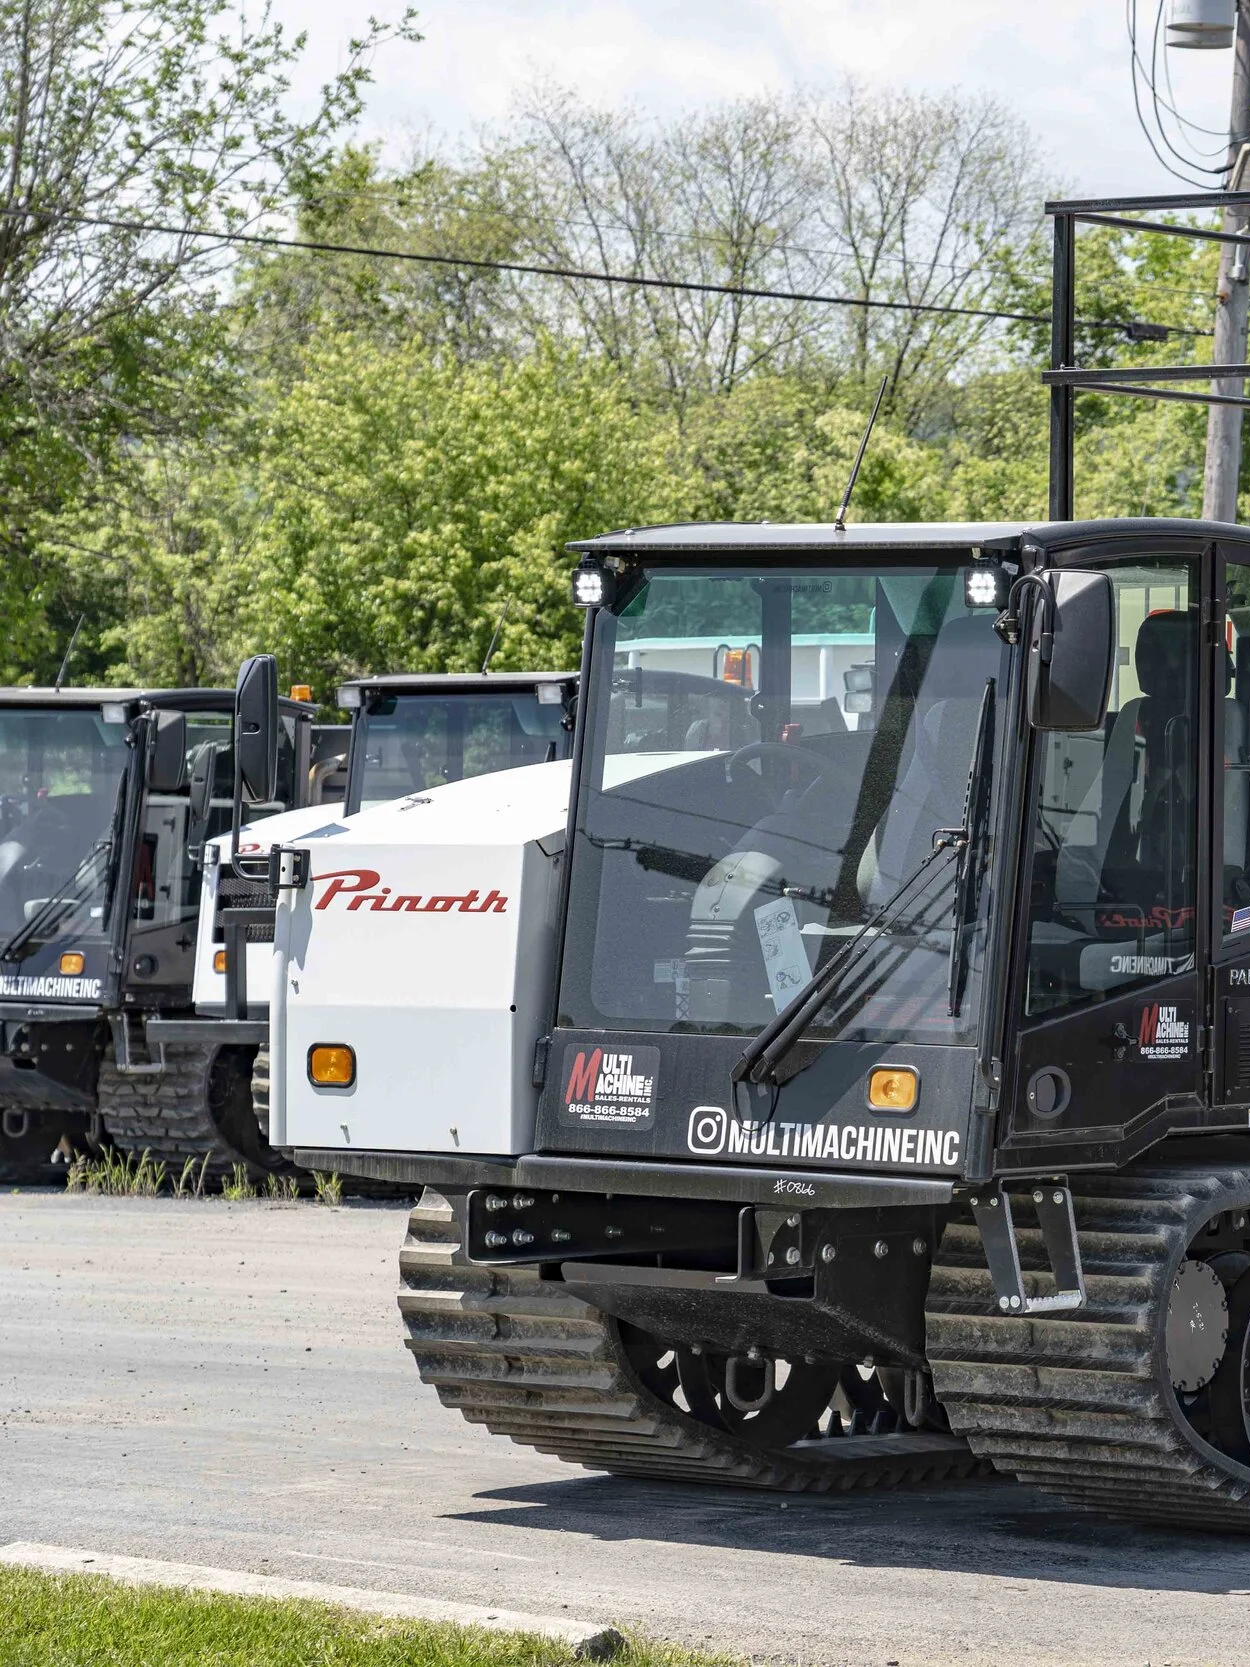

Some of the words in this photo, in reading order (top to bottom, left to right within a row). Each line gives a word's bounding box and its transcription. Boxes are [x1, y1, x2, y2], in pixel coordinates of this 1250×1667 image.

[310, 869, 509, 913] Prinoth
[1140, 1046, 1188, 1055] 866-866-8584
[595, 1094, 651, 1103] SALES-RENTALS
[568, 1103, 649, 1117] 866-866-8584
[728, 1119, 960, 1166] MULTIMACHINEINC
